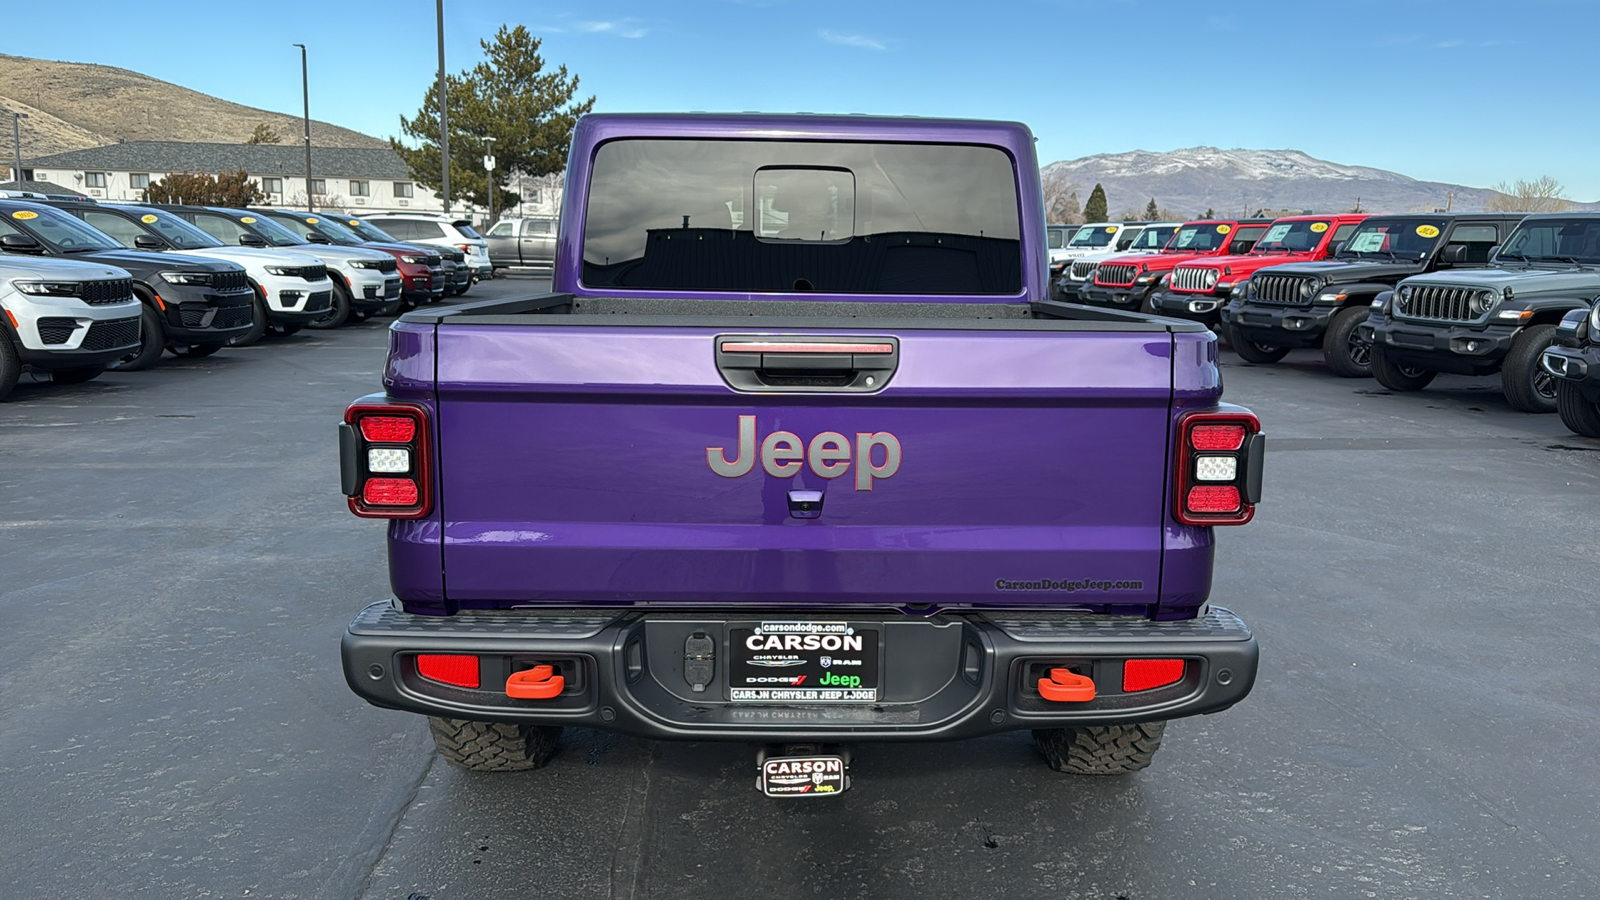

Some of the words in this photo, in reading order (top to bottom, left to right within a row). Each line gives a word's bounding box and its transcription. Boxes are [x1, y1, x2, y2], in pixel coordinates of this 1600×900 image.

[706, 415, 902, 491] Jeep
[995, 579, 1143, 592] CarsonDodgeJeep.com
[763, 622, 845, 633] carsondodge.com
[746, 635, 862, 651] CARSON
[819, 671, 861, 688] Jeep
[771, 690, 818, 700] CHRYSLER
[820, 690, 841, 700] JEEP
[767, 761, 840, 774] CARSON
